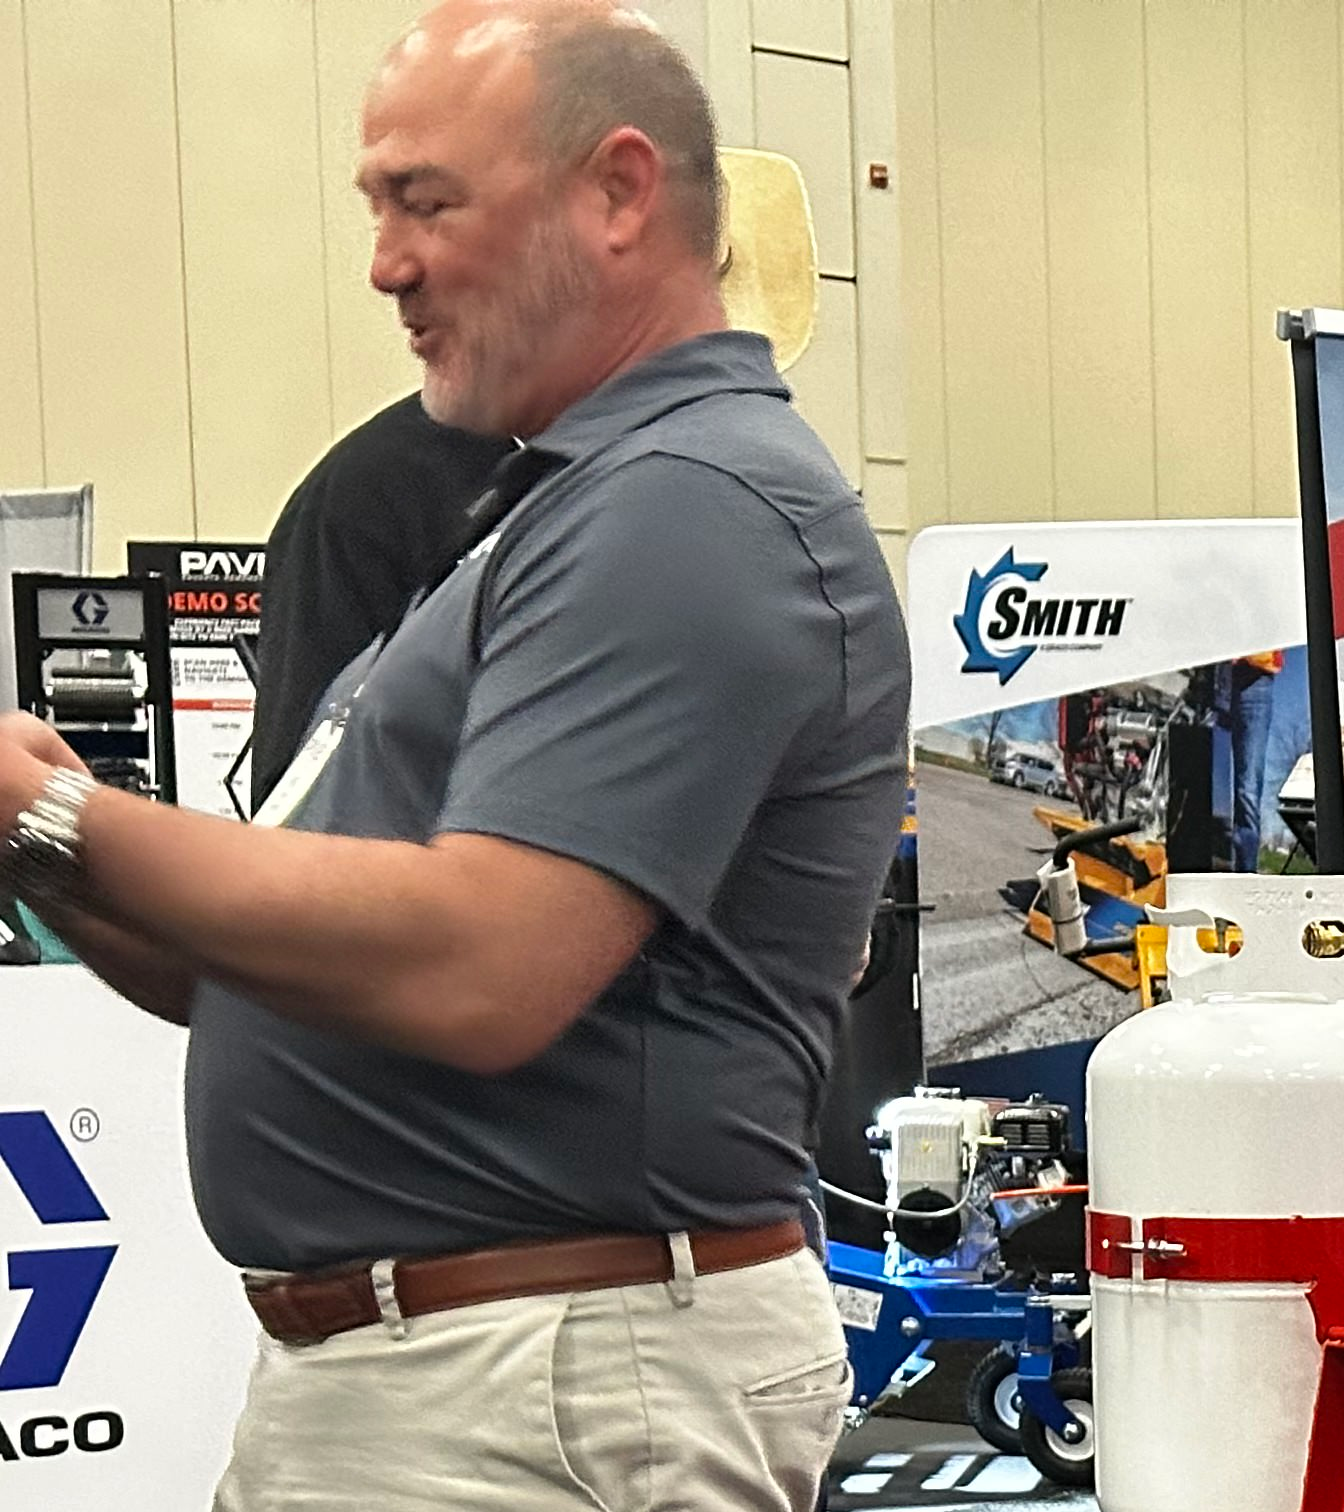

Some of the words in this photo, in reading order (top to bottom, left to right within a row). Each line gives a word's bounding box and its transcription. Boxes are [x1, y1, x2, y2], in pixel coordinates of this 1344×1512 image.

[180, 551, 266, 576] PAV
[168, 592, 228, 613] EMO
[987, 586, 1126, 640] SMITH
